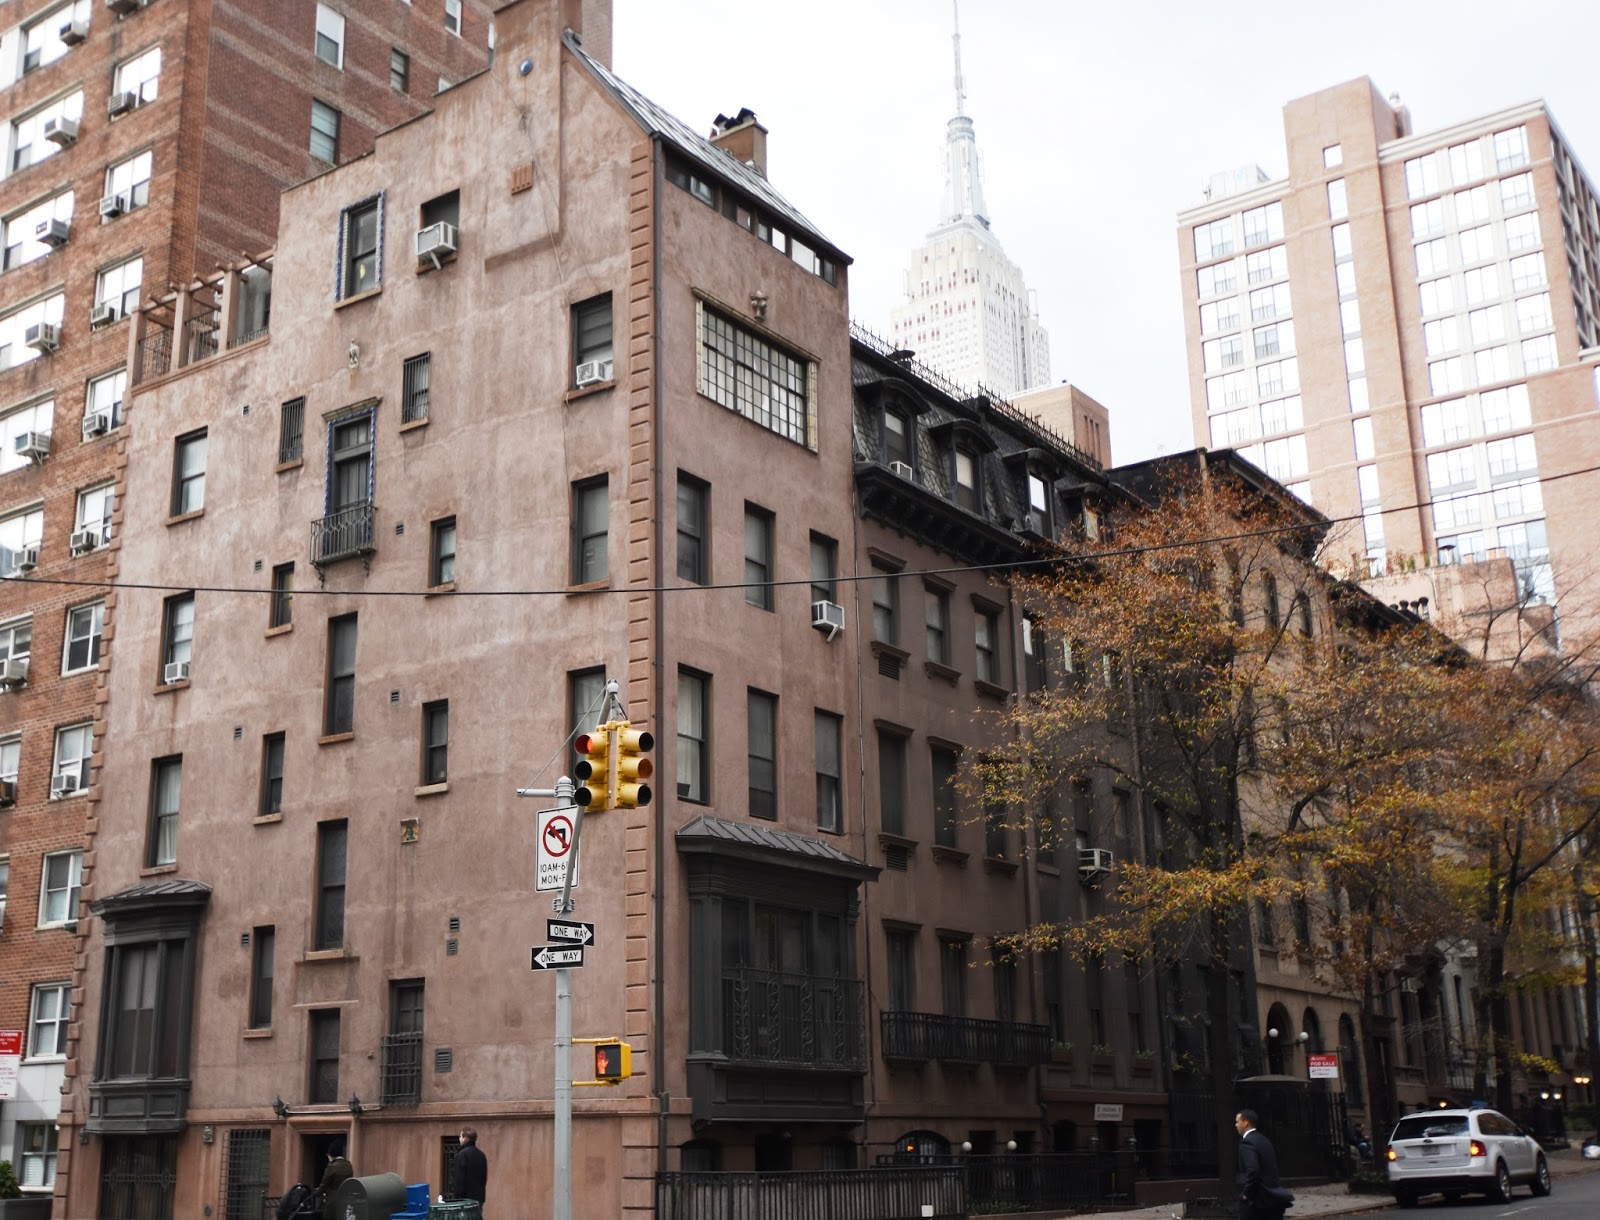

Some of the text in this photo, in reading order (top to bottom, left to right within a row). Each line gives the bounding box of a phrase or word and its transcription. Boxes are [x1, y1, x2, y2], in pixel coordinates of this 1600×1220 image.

[540, 861, 575, 873] 10AM-6
[541, 873, 571, 885] MON-F
[553, 926, 588, 939] ONE WAY
[540, 951, 579, 963] ONE WAY
